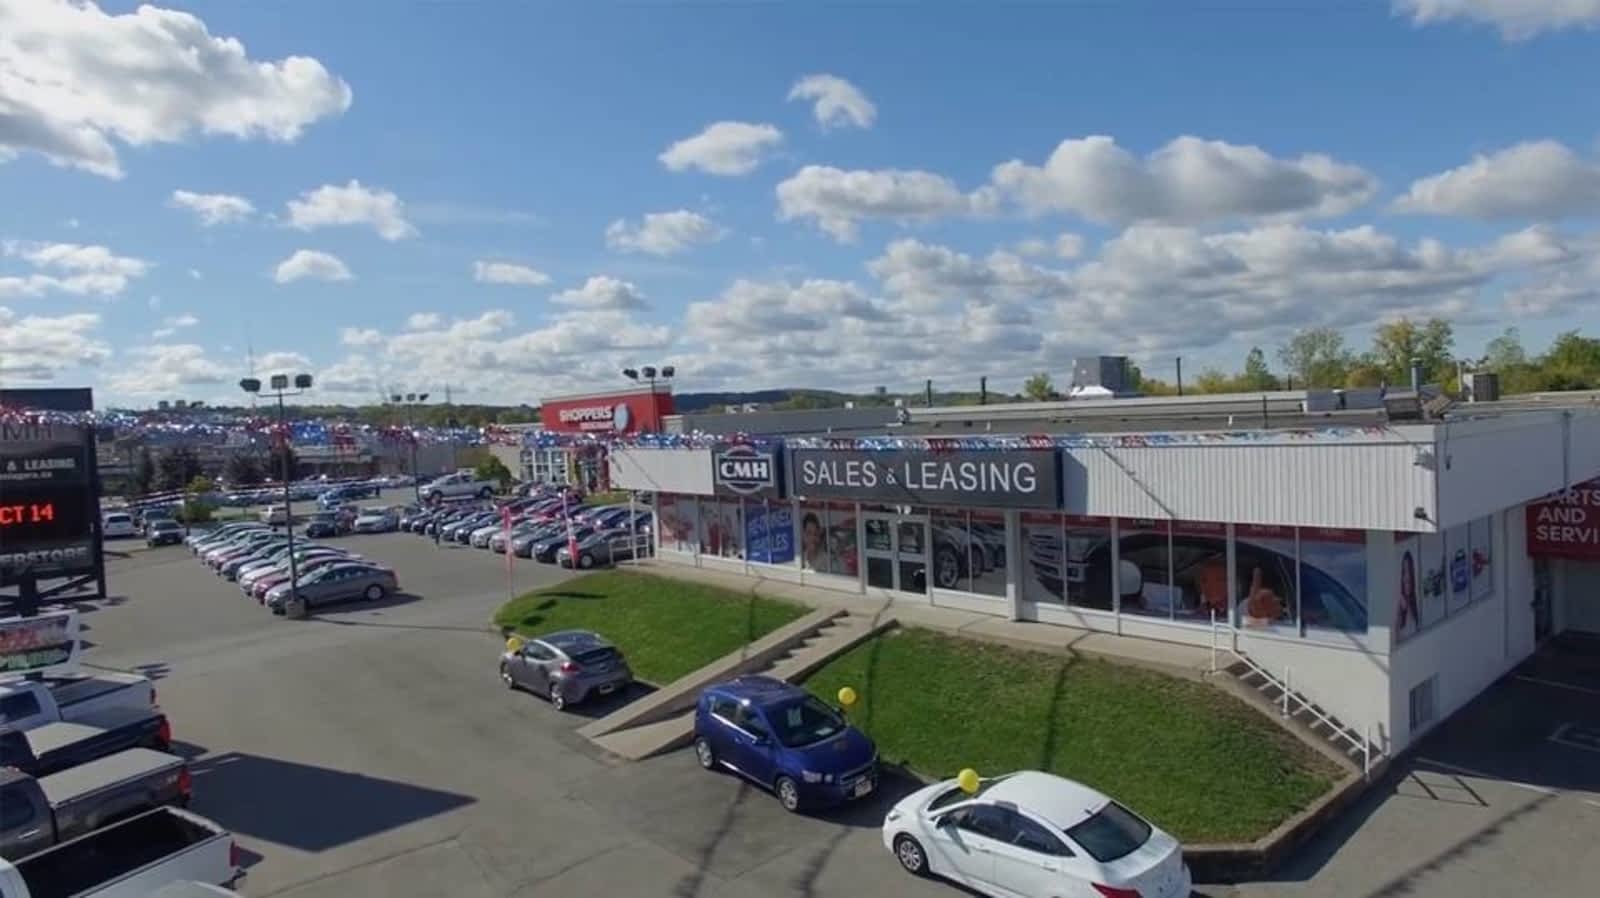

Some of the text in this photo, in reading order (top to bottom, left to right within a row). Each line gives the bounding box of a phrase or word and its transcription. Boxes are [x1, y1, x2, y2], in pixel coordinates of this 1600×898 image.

[559, 406, 613, 422] SHOPPERS
[24, 458, 75, 470] LEASING
[721, 461, 769, 479] CMH
[803, 460, 1037, 493] SALES & LEASING
[31, 503, 54, 522] 14
[1538, 506, 1587, 524] AND
[1536, 525, 1599, 545] SERVI
